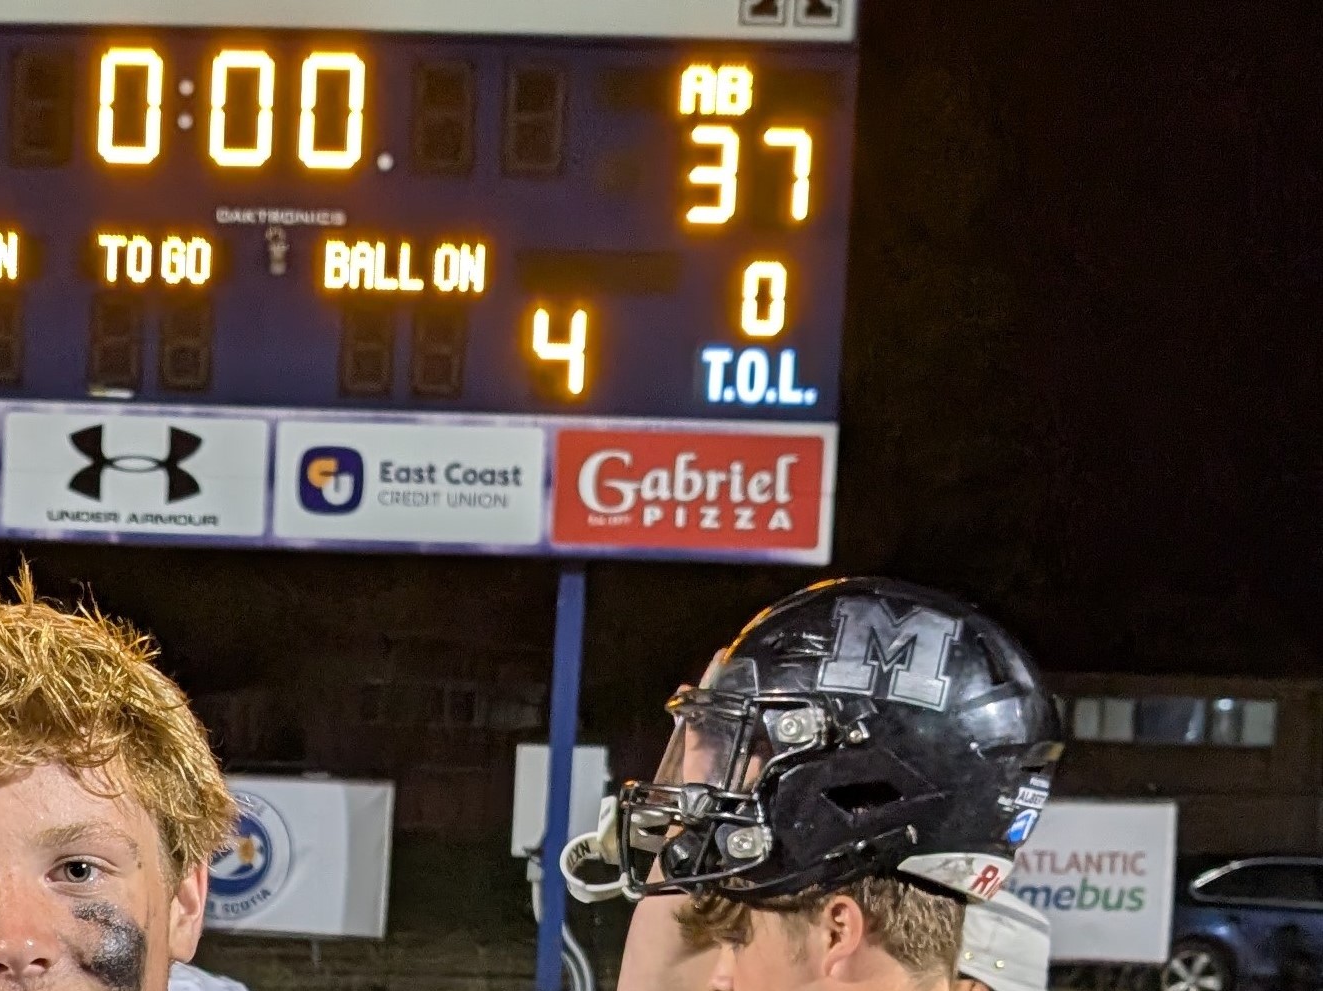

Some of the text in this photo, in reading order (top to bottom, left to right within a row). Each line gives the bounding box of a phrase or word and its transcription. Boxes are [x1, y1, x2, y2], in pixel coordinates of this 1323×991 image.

[679, 63, 753, 116] AB
[686, 125, 812, 224] 37
[97, 232, 212, 285] TO GO
[324, 240, 485, 293] BALL ON
[741, 261, 787, 337] 0
[532, 308, 588, 395] 4
[702, 347, 818, 406] T.O.L.
[378, 490, 508, 508] CREDIT UNION
[379, 461, 523, 486] East Coast
[577, 449, 798, 514] Gabriel
[47, 510, 219, 526] UNDER ARMOUR
[643, 506, 793, 530] PIZZA
[817, 598, 961, 711] M
[1015, 851, 1147, 876] ATLANTIC
